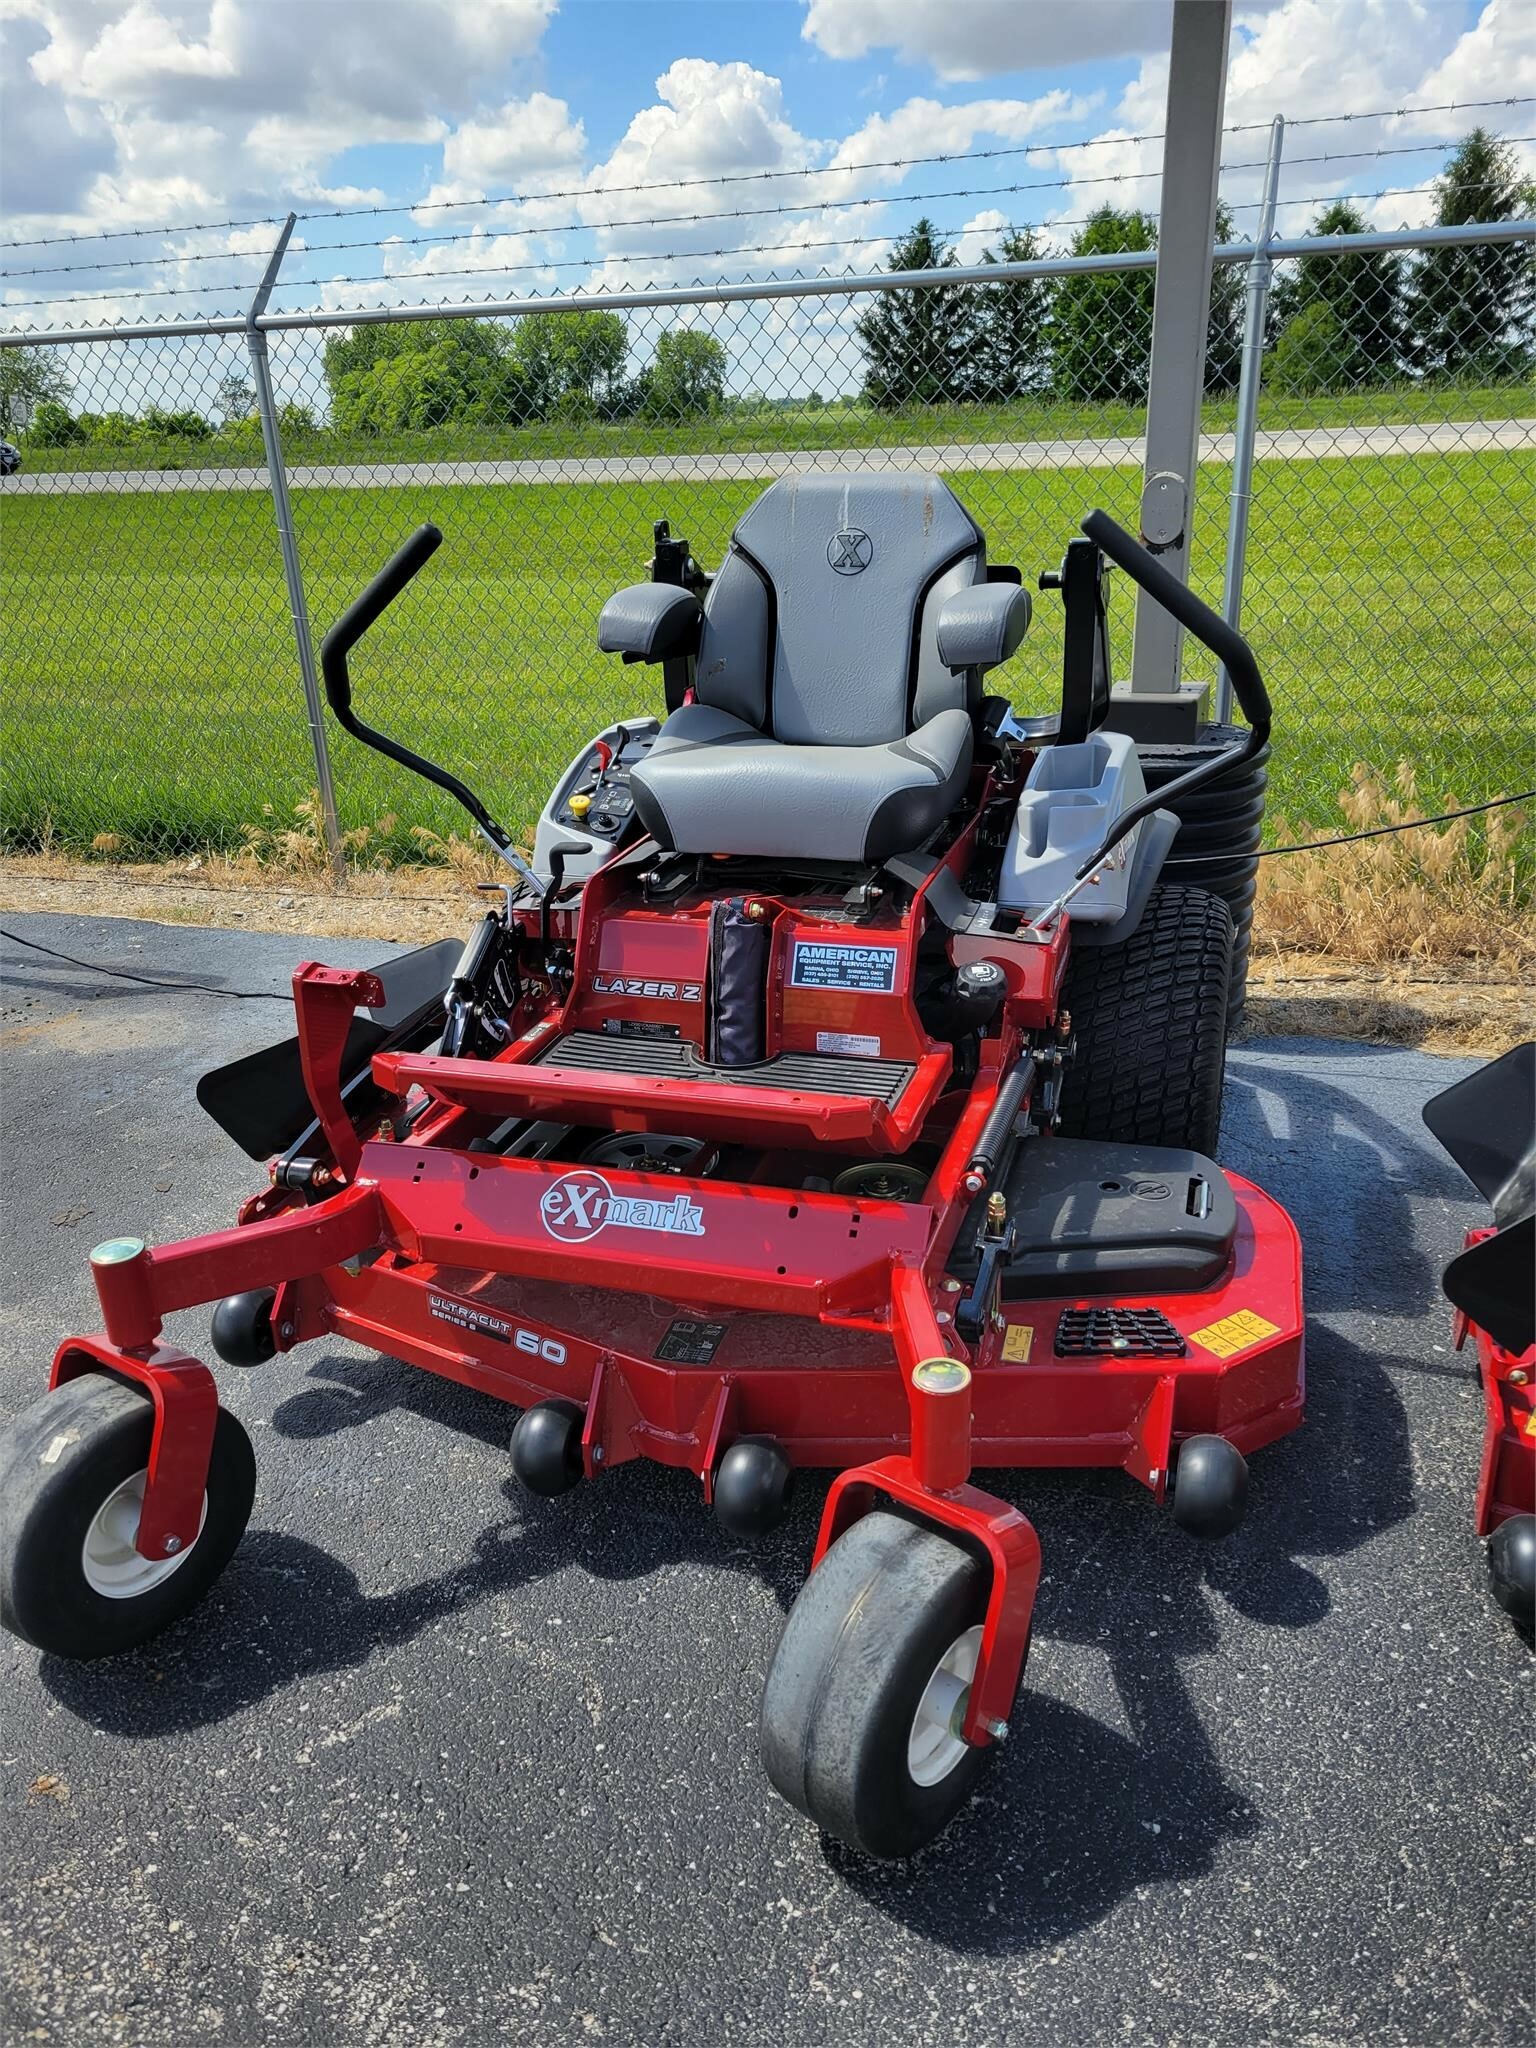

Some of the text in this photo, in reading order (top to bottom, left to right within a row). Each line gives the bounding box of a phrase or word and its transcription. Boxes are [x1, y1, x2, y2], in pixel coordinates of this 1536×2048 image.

[833, 534, 866, 568] X
[798, 946, 894, 964] AMERICAN
[799, 957, 841, 966] EQUIPMENT
[841, 960, 874, 970] SERVICE,
[593, 976, 701, 1001] LAZER Z
[430, 1295, 512, 1333] ULTRACUT
[431, 1308, 467, 1327] SERIES
[514, 1328, 567, 1365] 60
